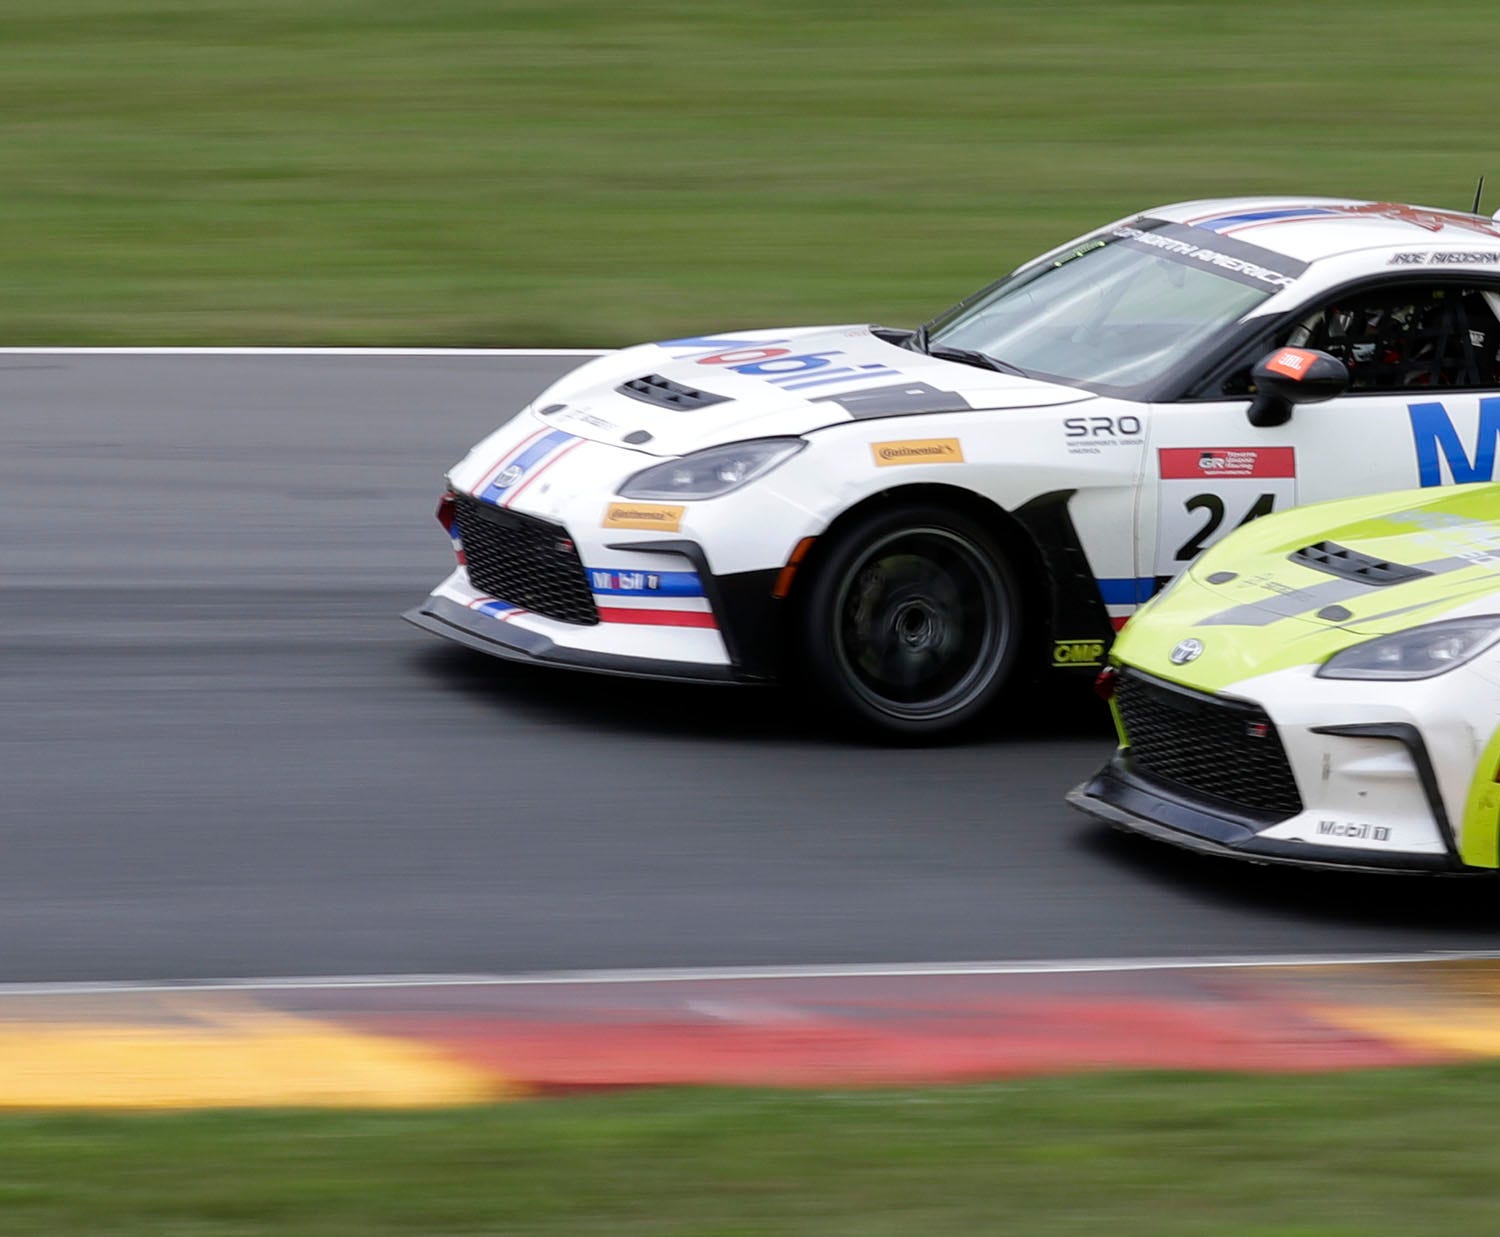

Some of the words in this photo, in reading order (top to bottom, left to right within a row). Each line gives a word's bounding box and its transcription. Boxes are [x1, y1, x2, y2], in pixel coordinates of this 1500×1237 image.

[1064, 416, 1141, 437] SRO
[1199, 458, 1225, 469] GR
[1053, 643, 1104, 663] OMP
[1318, 821, 1369, 839] Mobil
